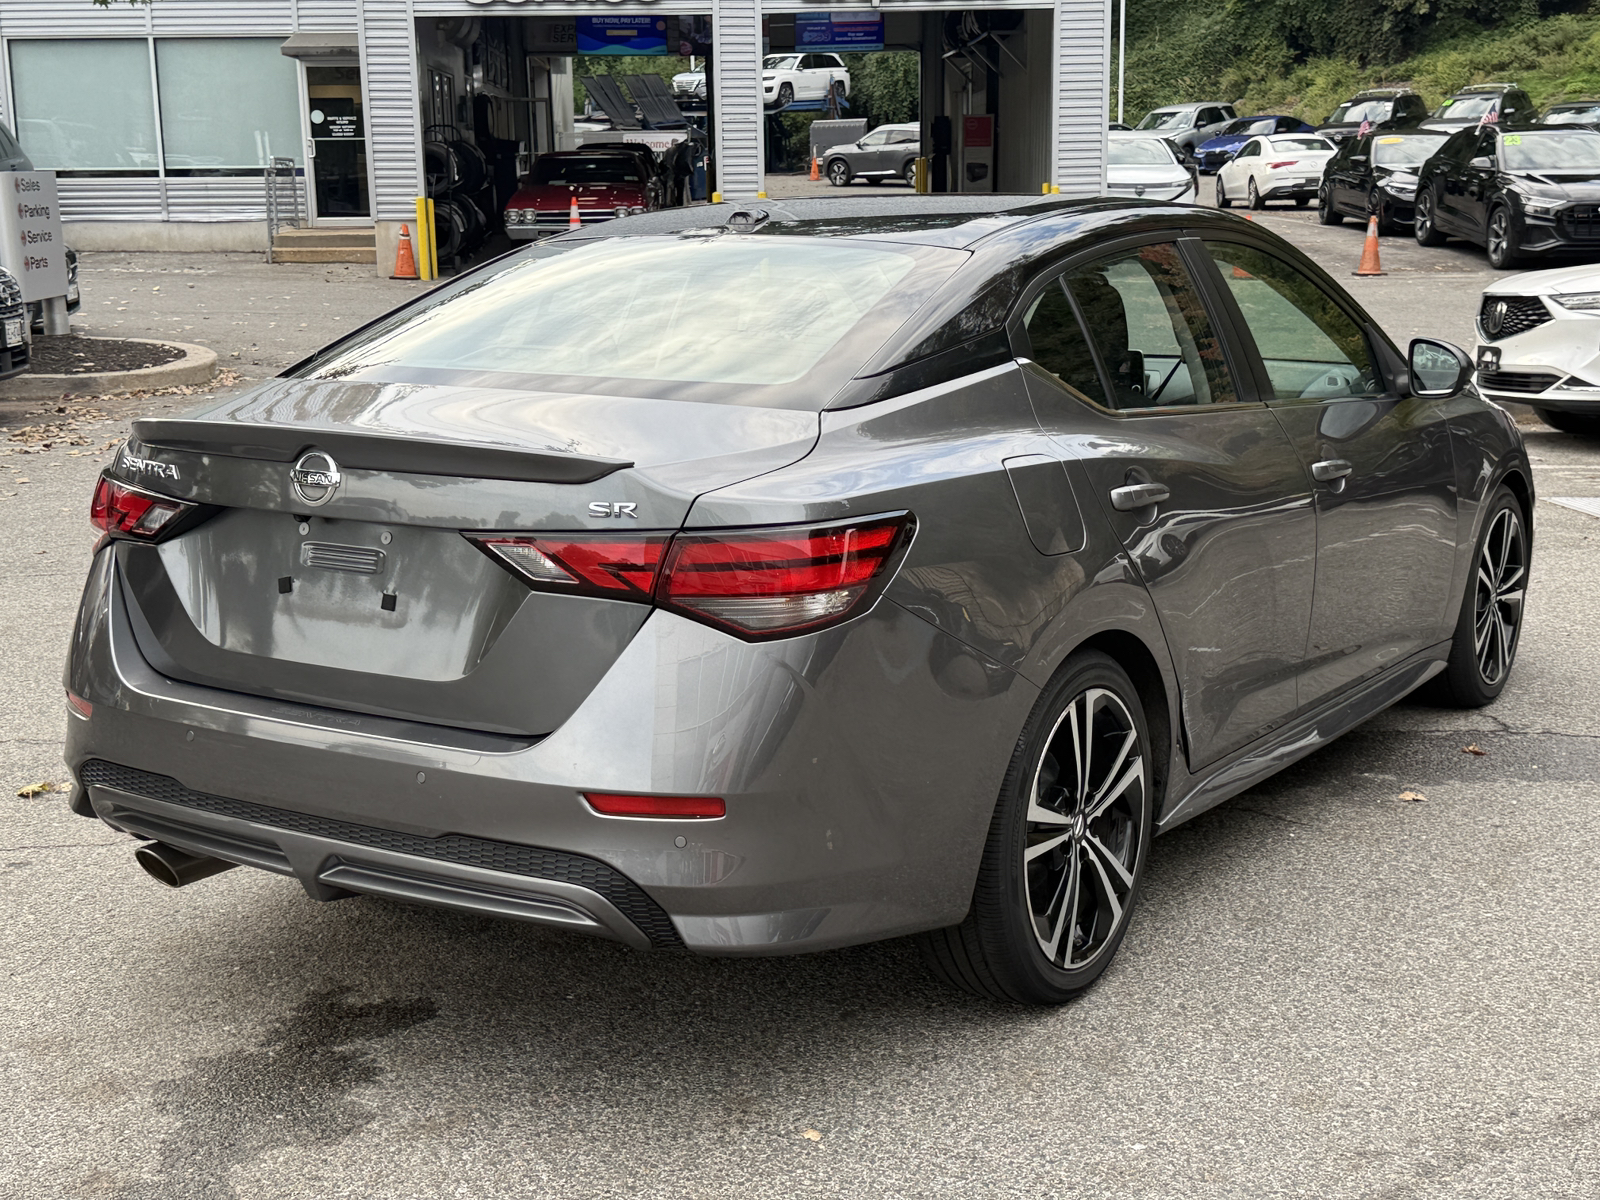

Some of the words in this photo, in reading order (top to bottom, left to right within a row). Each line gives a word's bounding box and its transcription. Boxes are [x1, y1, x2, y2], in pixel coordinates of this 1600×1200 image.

[554, 24, 575, 34] EXP
[553, 33, 575, 43] SER
[20, 178, 41, 192] Sales
[24, 204, 51, 219] Parking
[27, 230, 53, 244] Service
[30, 256, 49, 270] Parts
[121, 456, 181, 480] SENTRA
[294, 469, 333, 484] NISSAN
[588, 501, 638, 519] SR
